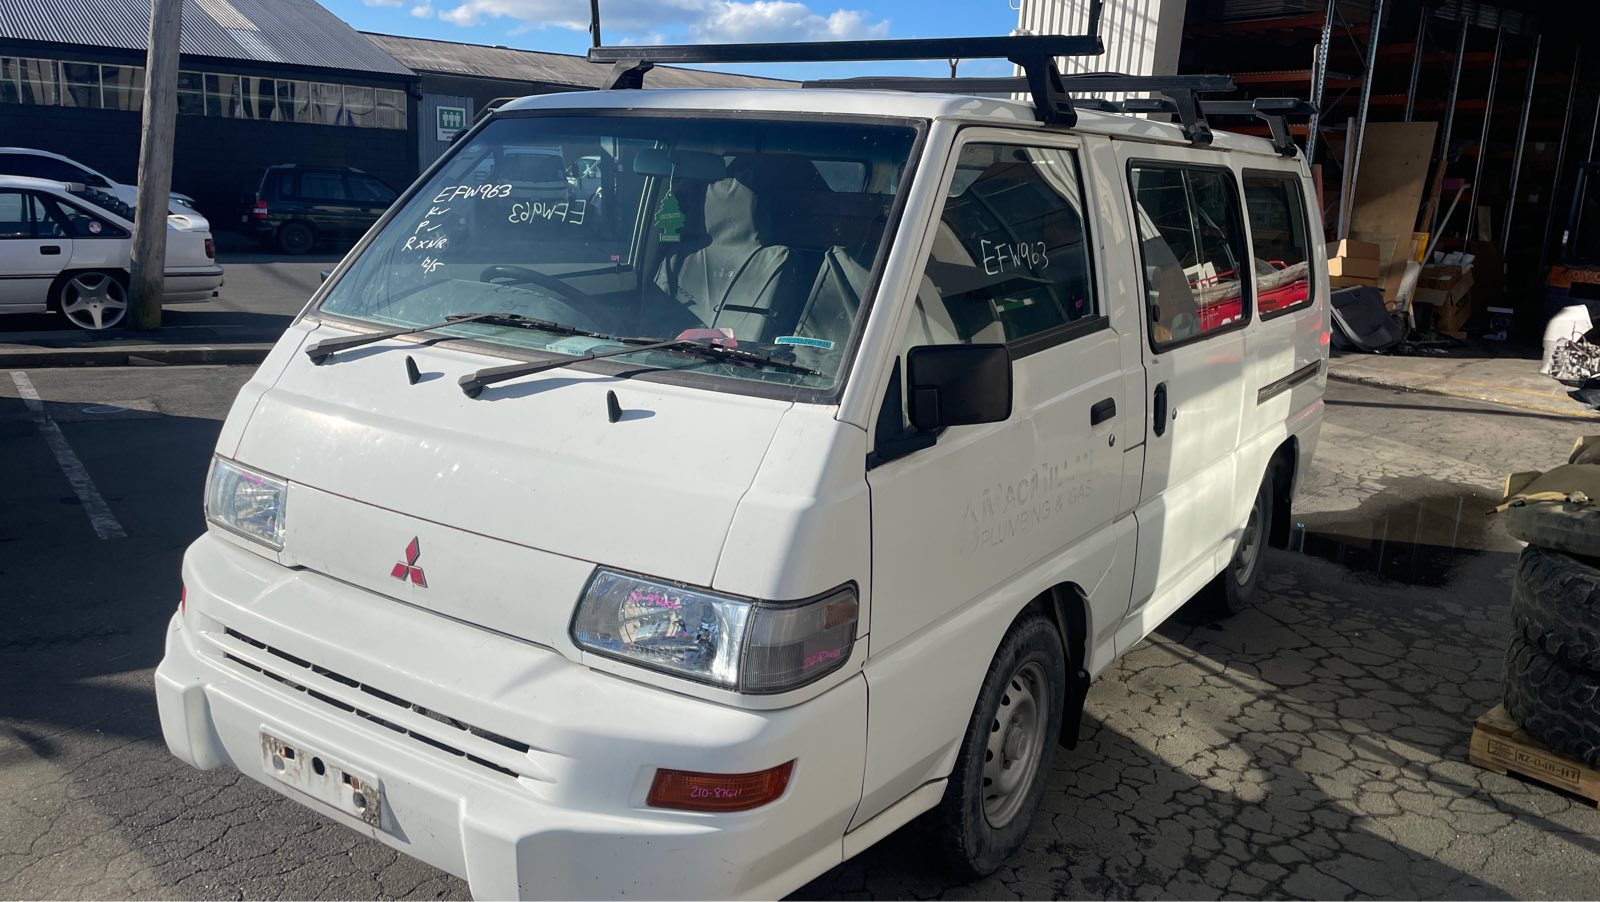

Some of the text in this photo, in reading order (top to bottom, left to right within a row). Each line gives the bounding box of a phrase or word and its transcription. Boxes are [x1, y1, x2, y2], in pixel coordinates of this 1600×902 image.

[433, 183, 512, 203] EFW963
[980, 239, 1049, 275] EFW963
[980, 500, 1050, 552] PLUMBING
[1068, 479, 1093, 505] GAS
